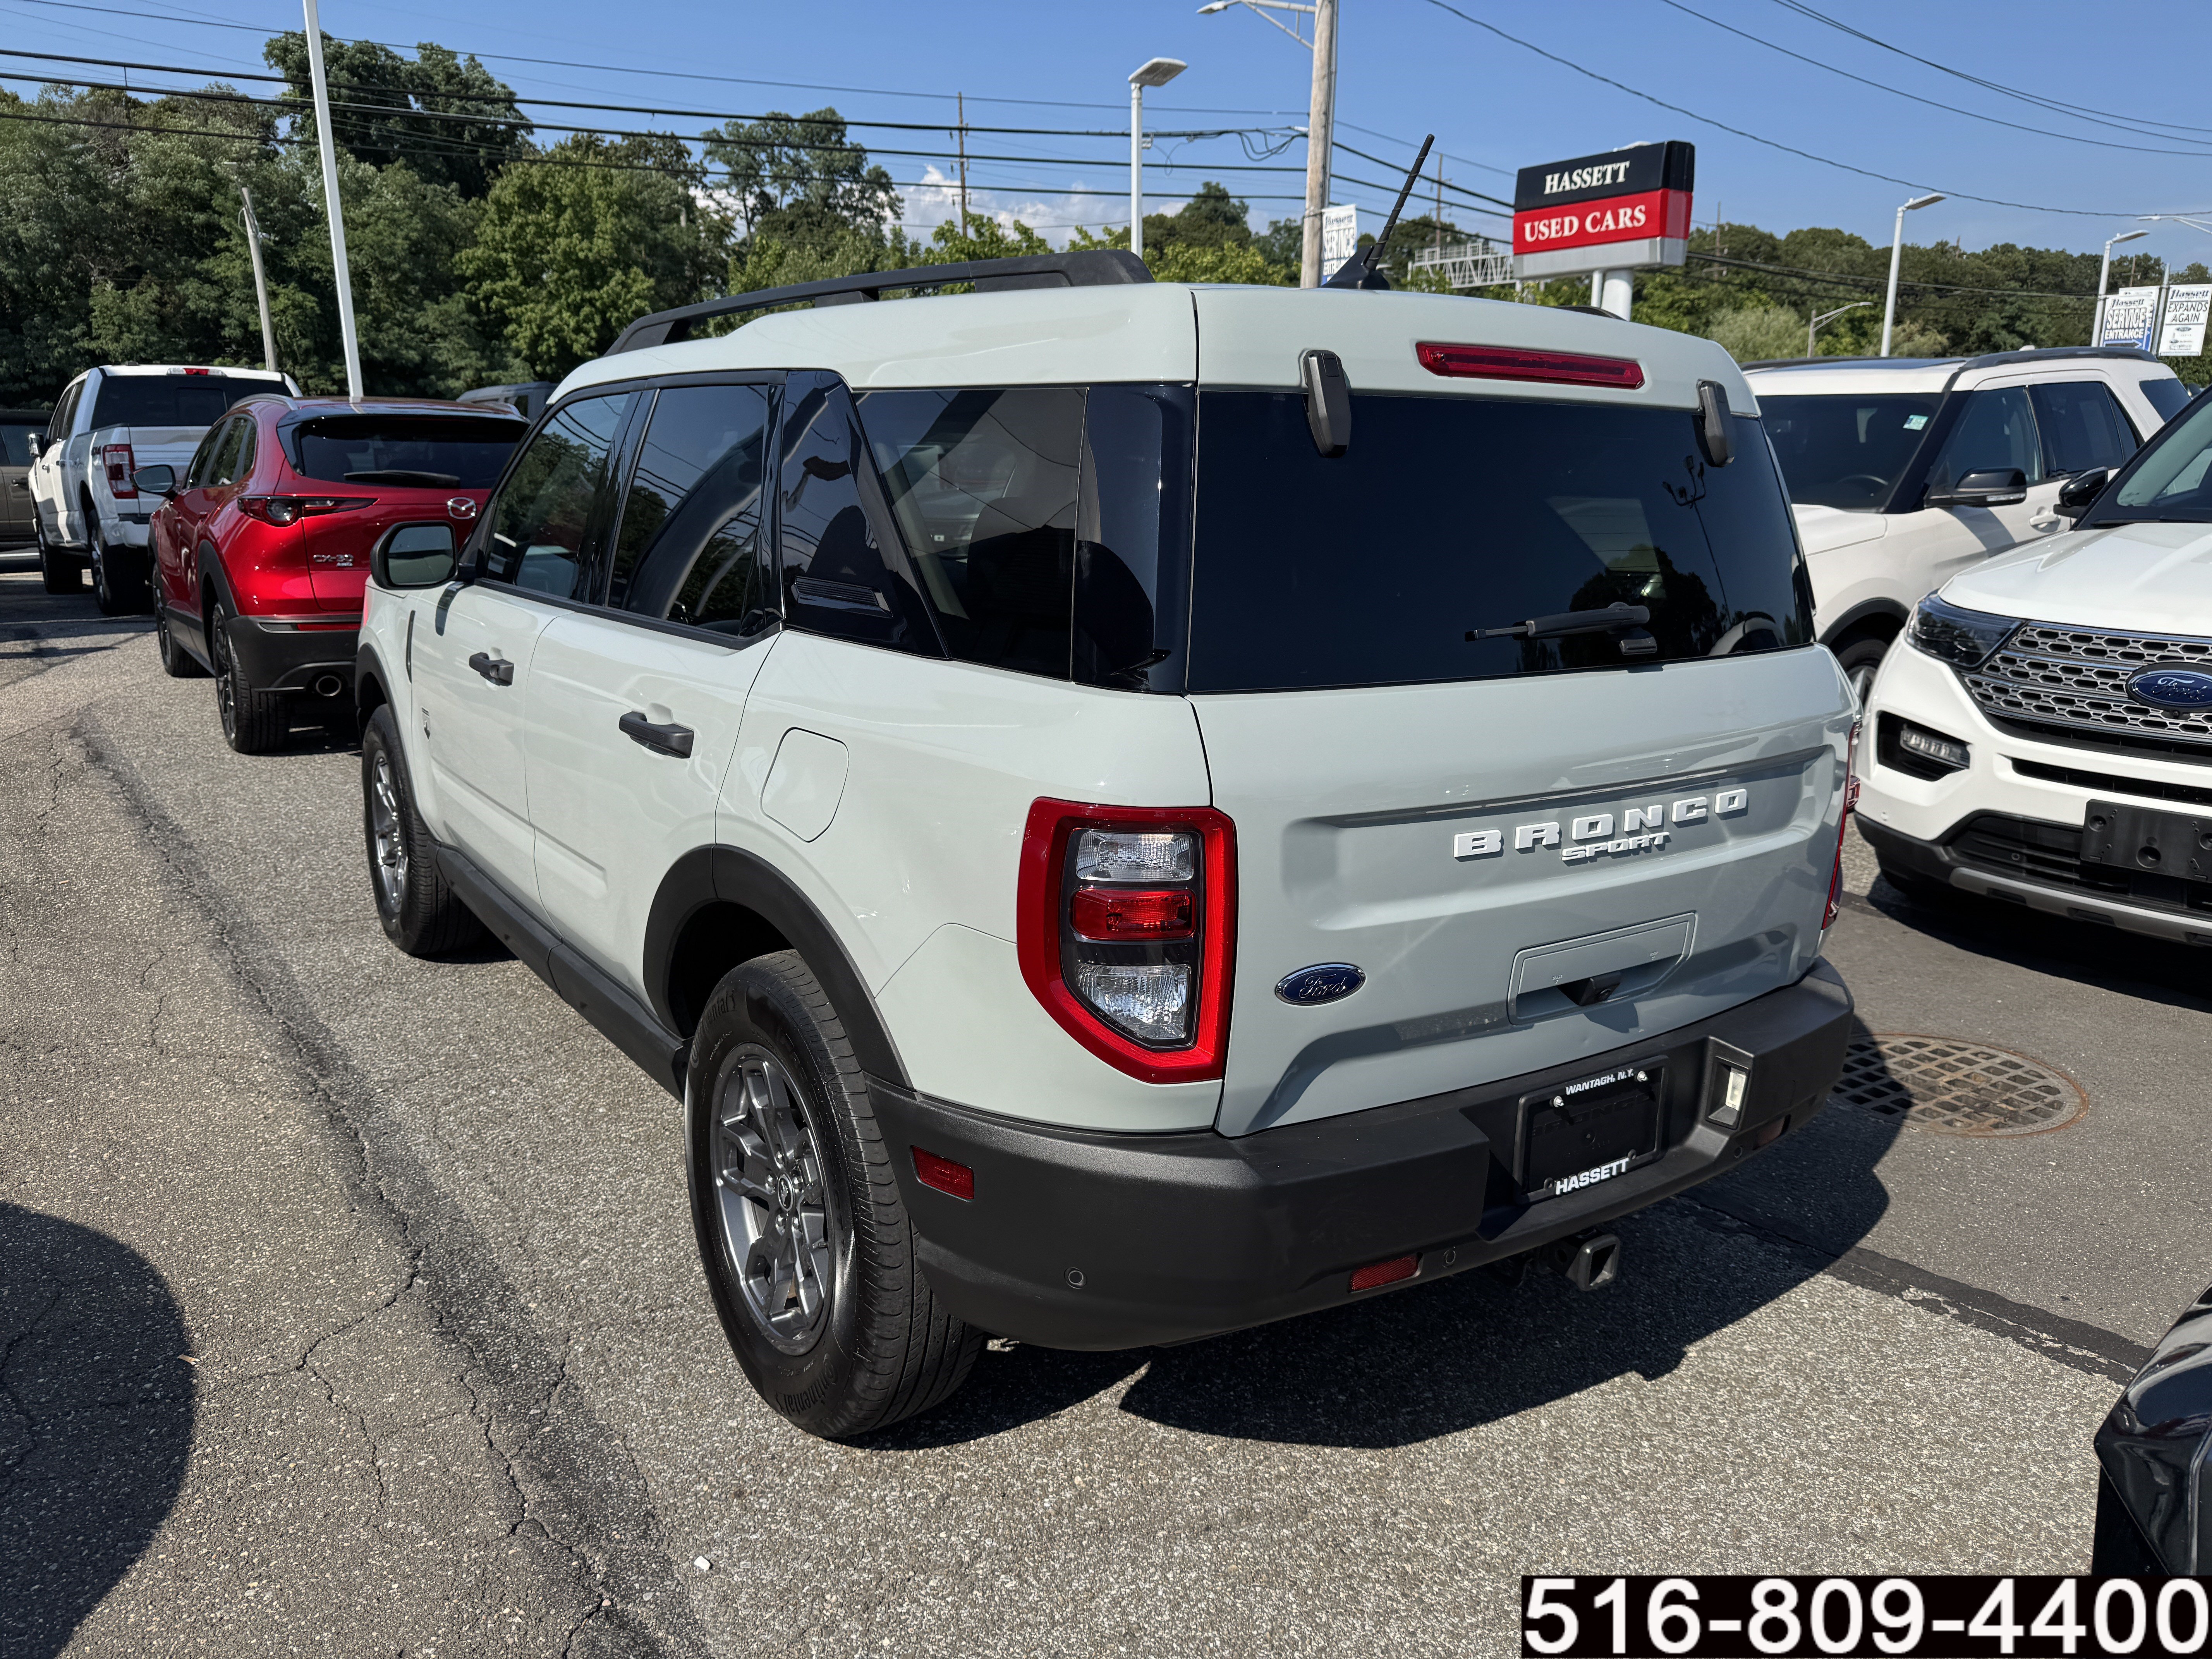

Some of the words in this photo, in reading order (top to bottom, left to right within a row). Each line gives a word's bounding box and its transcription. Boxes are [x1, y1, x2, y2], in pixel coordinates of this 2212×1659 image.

[1544, 161, 1630, 195] HASSETT
[1524, 215, 1579, 242] USED
[1585, 205, 1646, 233] CARS
[2106, 307, 2146, 329] SERVICE
[2168, 302, 2209, 313] EXPANDS
[2171, 313, 2200, 322] AGAIN
[2104, 329, 2144, 340] ENTRANCE
[1454, 788, 1747, 858] BRONCO
[1561, 831, 1669, 861] SPORT
[1299, 974, 1347, 998] Ford
[690, 990, 730, 1068] Coental
[1565, 1074, 1616, 1095] WANTAGH,
[1617, 1068, 1634, 1080] N.Y.
[1555, 1157, 1629, 1195] HASSETT
